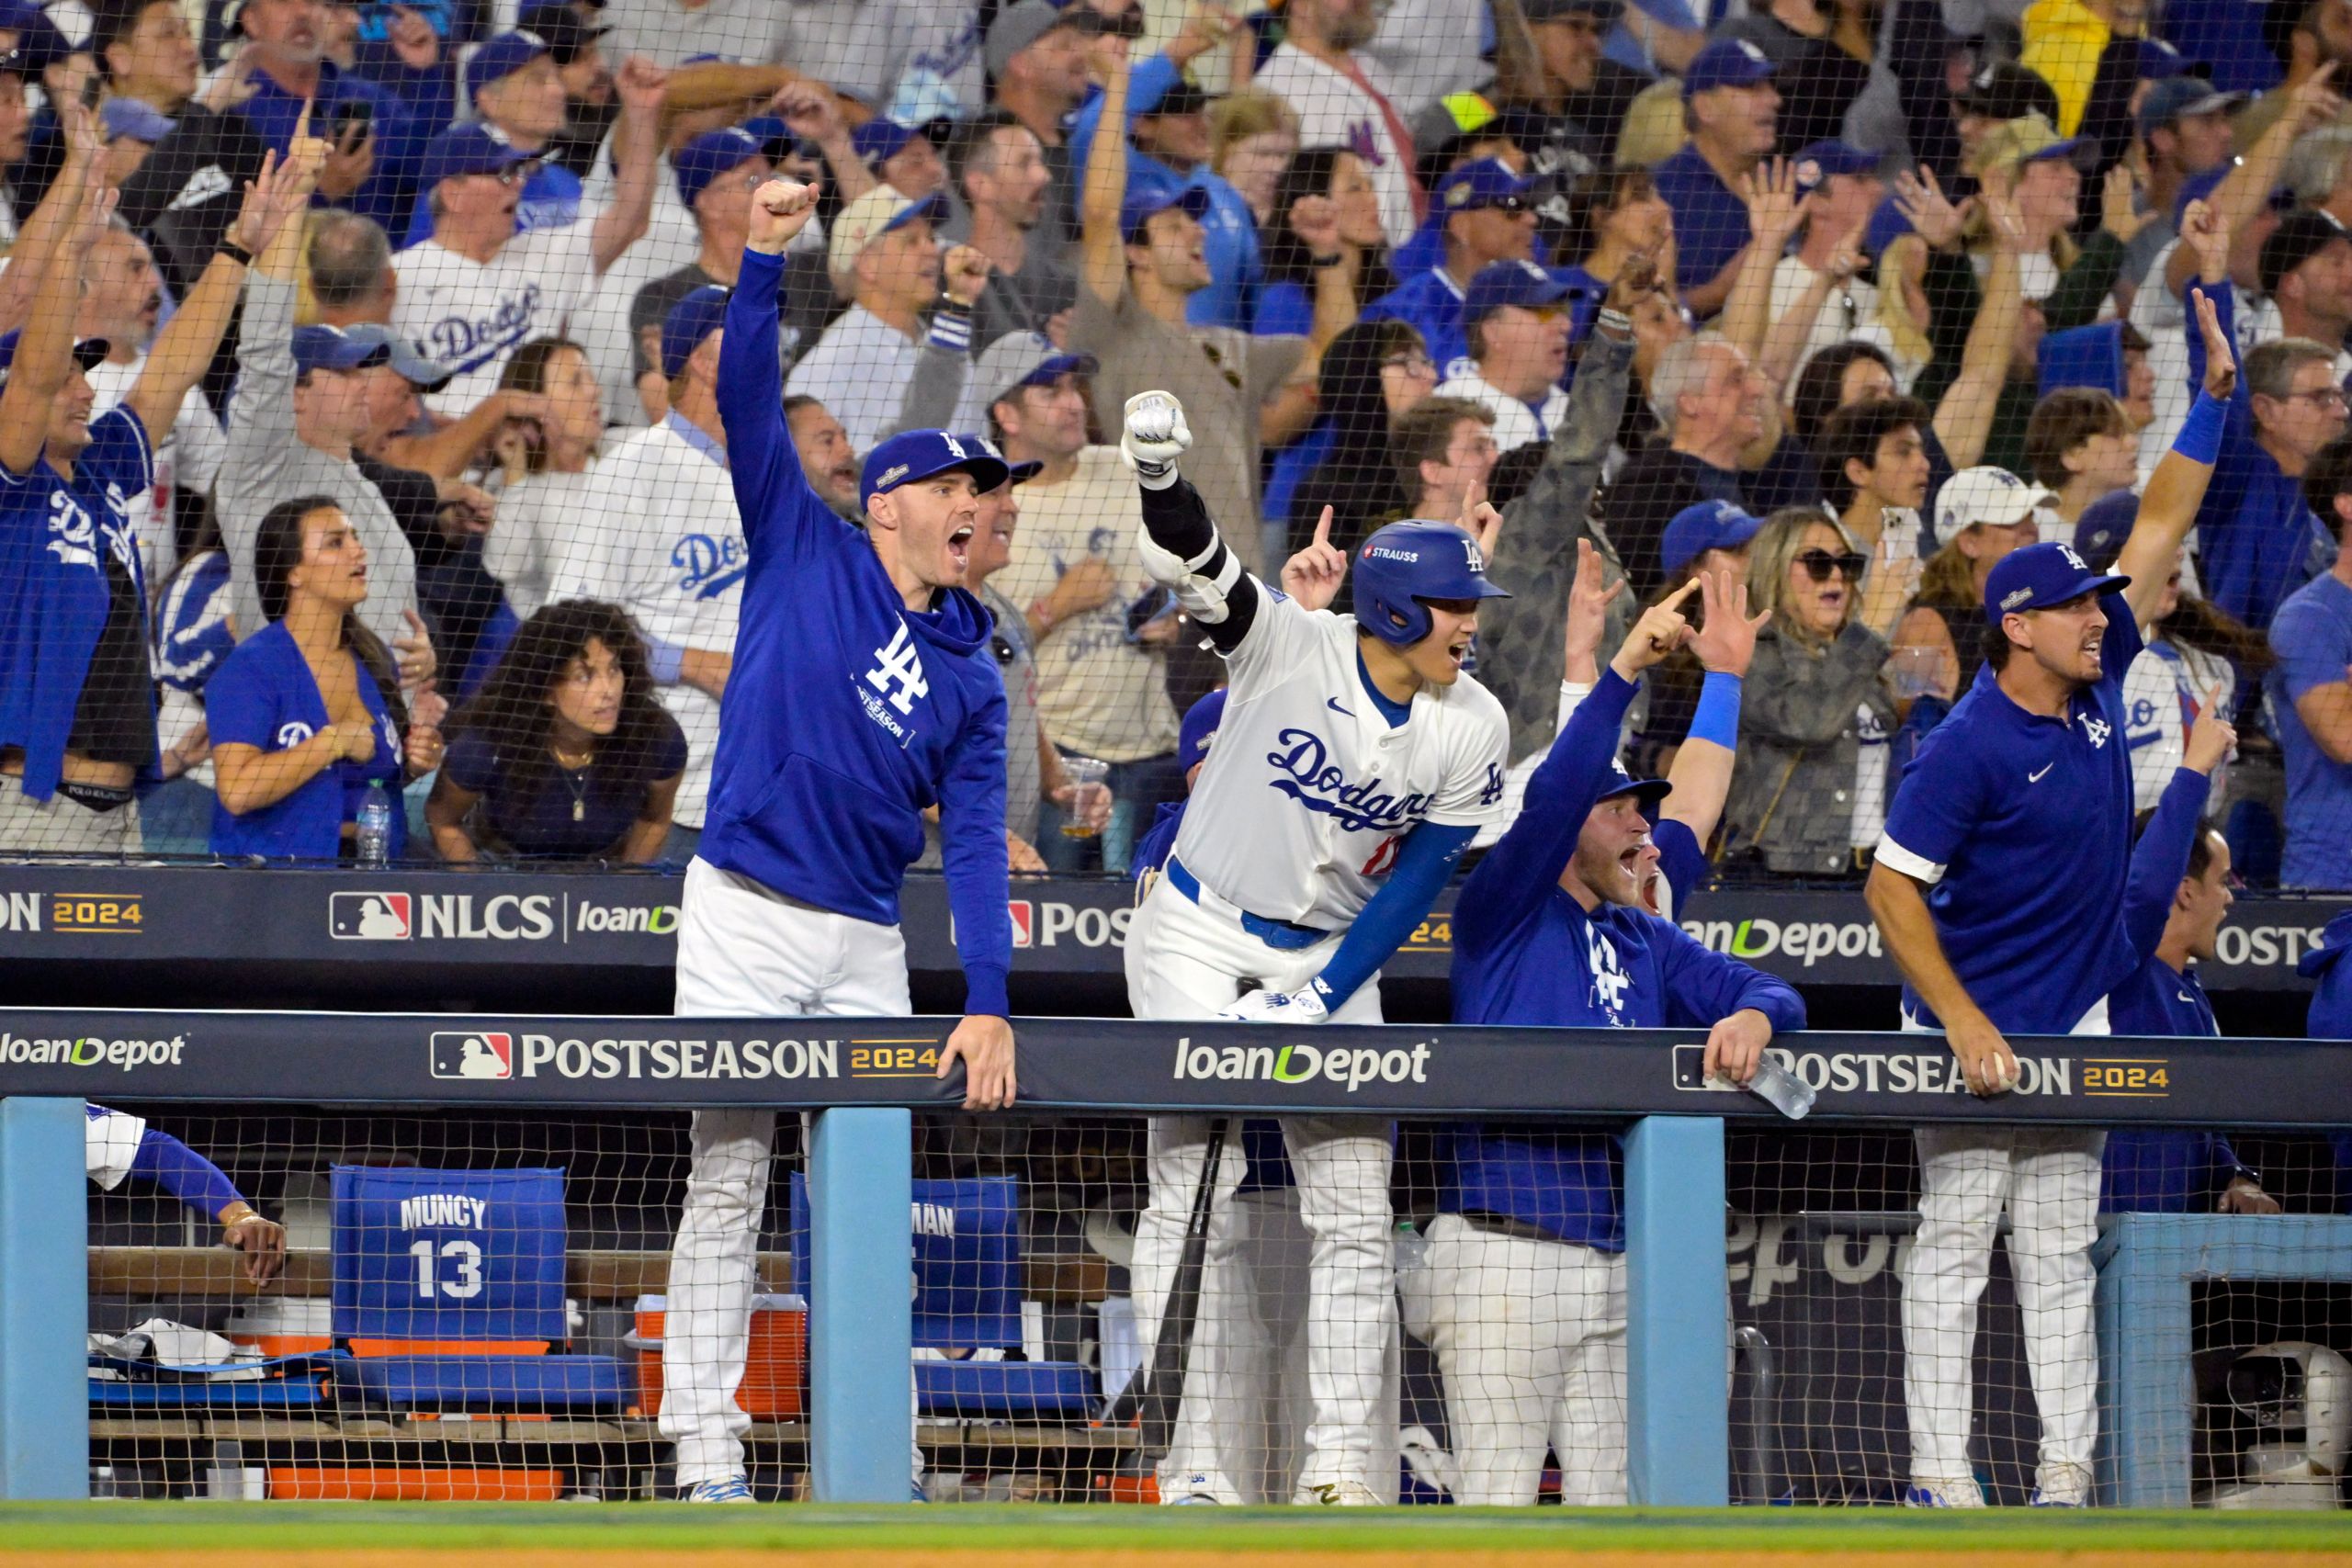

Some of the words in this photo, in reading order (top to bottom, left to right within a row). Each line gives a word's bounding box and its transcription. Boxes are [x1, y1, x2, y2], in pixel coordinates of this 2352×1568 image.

[940, 432, 967, 459] LA
[1372, 547, 1419, 563] STRAUSS
[1462, 540, 1484, 572] LA
[2056, 546, 2087, 570] LA
[865, 610, 929, 716] LA
[2077, 712, 2111, 749] LA
[1480, 761, 1505, 806] LA
[0, 893, 41, 931] N
[53, 903, 143, 923] 2024
[420, 895, 553, 940] NLCS
[2187, 926, 2325, 965] OST
[0, 1032, 185, 1072] loanDepot
[520, 1034, 839, 1079] POSTSEASON
[851, 1048, 939, 1068] 2024
[1173, 1037, 1430, 1092] loanDepot
[2083, 1067, 2169, 1088] 2024
[401, 1194, 486, 1231] MUNCY
[409, 1240, 482, 1297] 13
